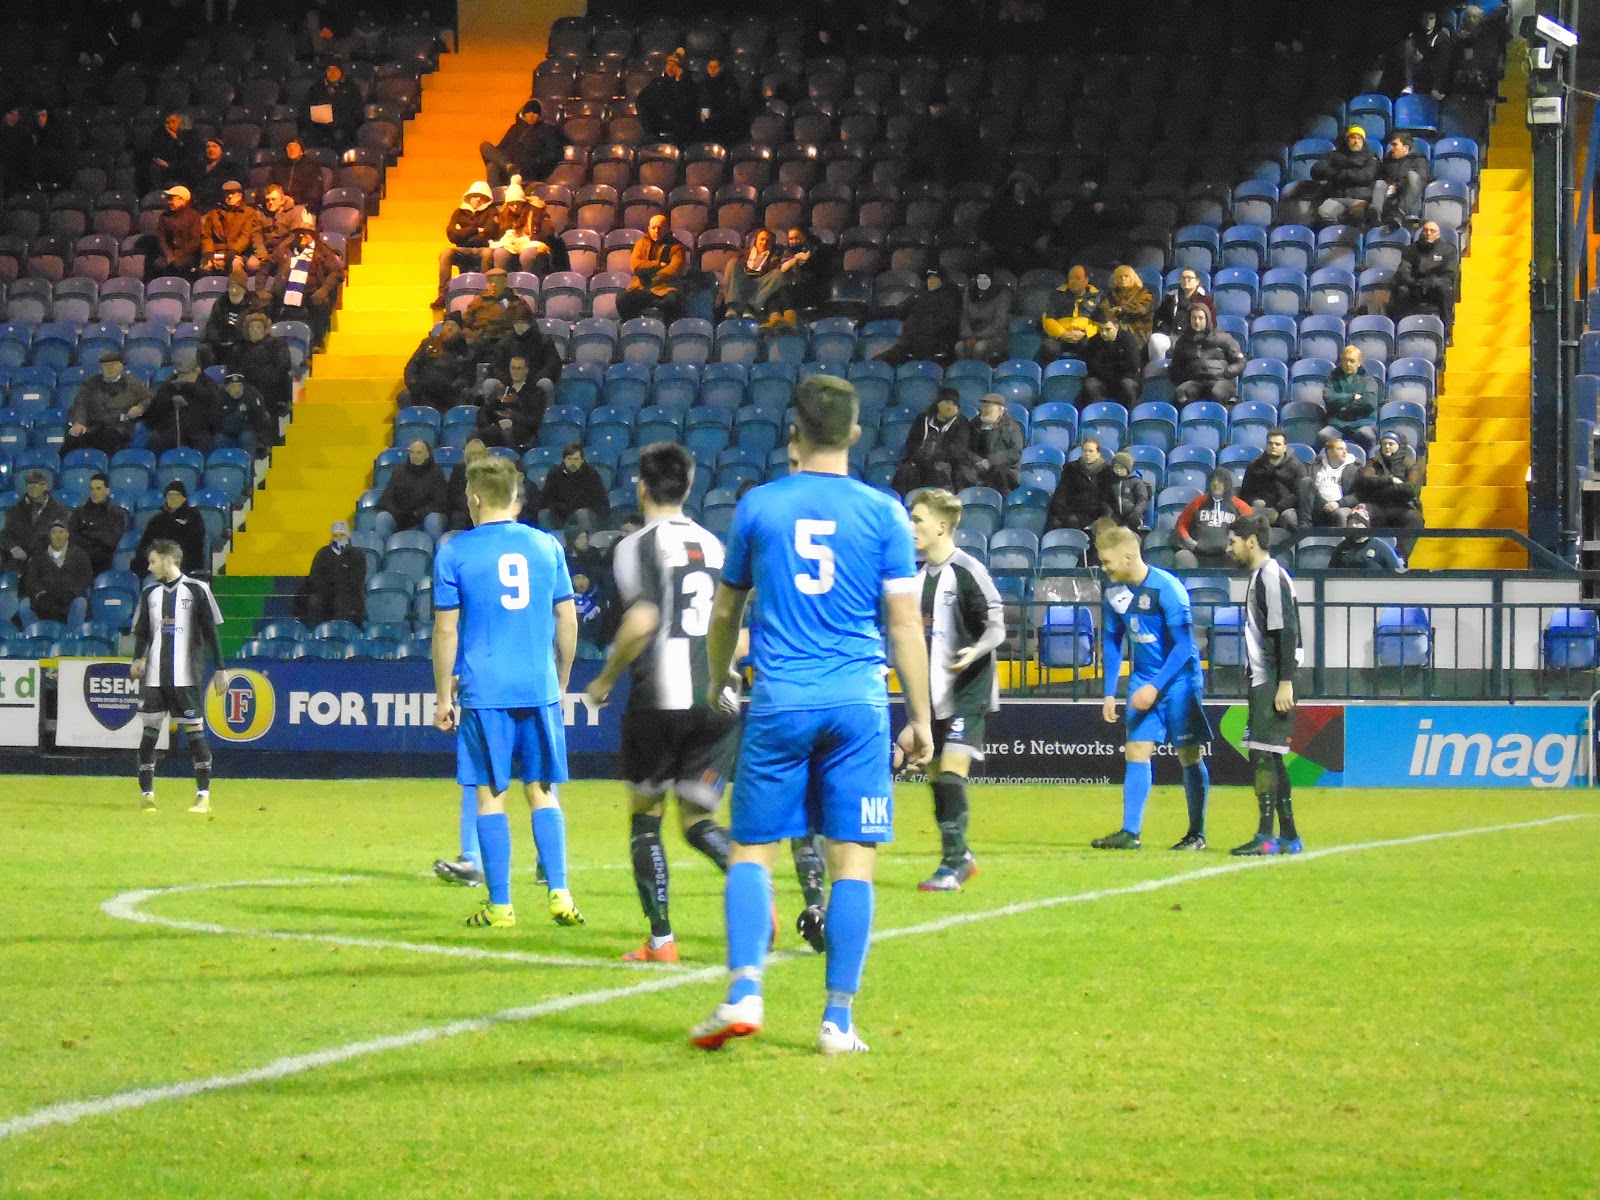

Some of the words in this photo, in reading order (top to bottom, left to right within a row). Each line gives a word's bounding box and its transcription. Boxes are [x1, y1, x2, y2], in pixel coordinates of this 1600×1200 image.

[794, 519, 836, 595] 5
[498, 553, 530, 610] 9
[680, 570, 716, 637] 3
[89, 676, 140, 695] ESEM
[289, 691, 368, 726] FOR
[371, 692, 438, 726] THE
[1012, 740, 1026, 755] &
[1029, 740, 1115, 756] Networks
[861, 796, 889, 825] NK
